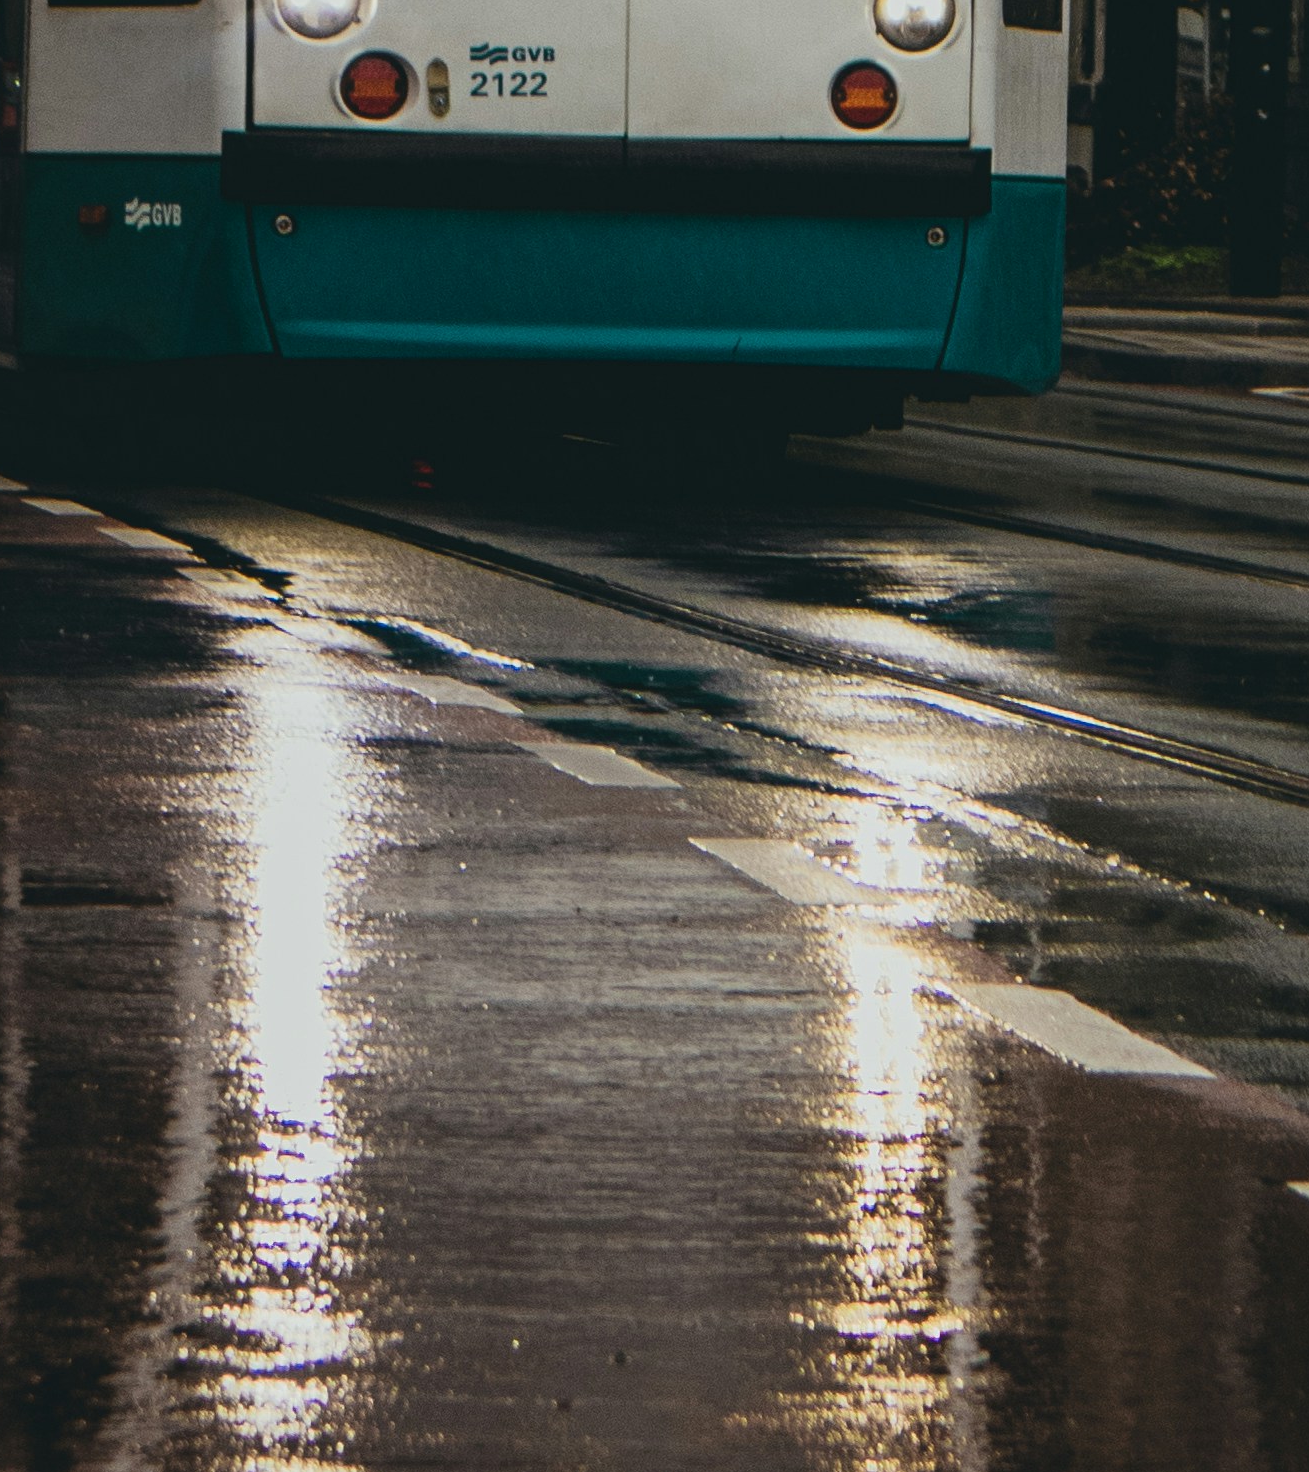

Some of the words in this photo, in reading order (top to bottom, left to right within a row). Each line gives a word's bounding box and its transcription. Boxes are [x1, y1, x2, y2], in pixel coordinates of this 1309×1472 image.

[511, 46, 555, 62] GVB
[470, 71, 548, 97] 2122
[152, 202, 182, 226] GVB
